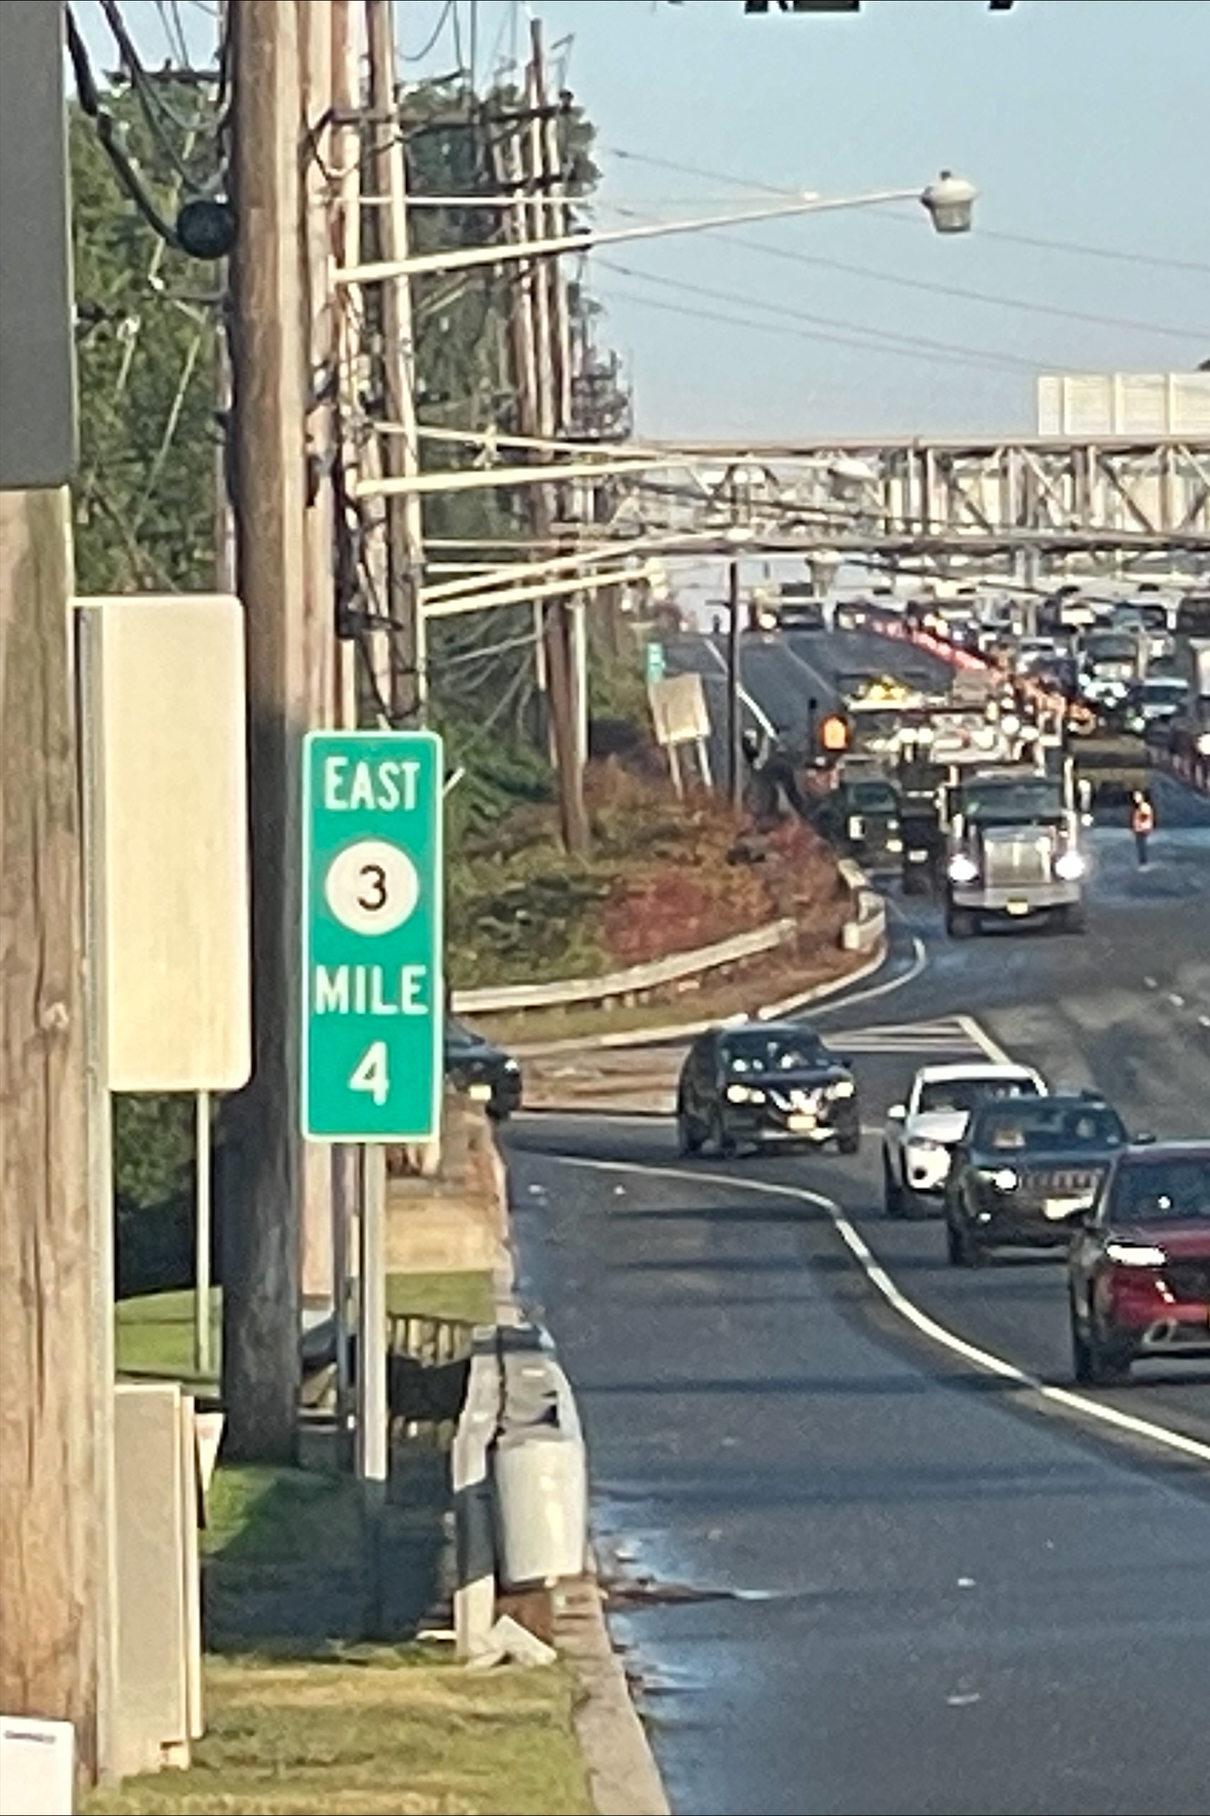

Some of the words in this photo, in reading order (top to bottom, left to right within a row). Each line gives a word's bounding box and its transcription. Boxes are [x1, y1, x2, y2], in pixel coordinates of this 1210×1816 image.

[323, 756, 420, 811] EAST
[356, 864, 389, 912] 3
[314, 965, 429, 1015] MILE
[347, 1040, 390, 1107] 4
